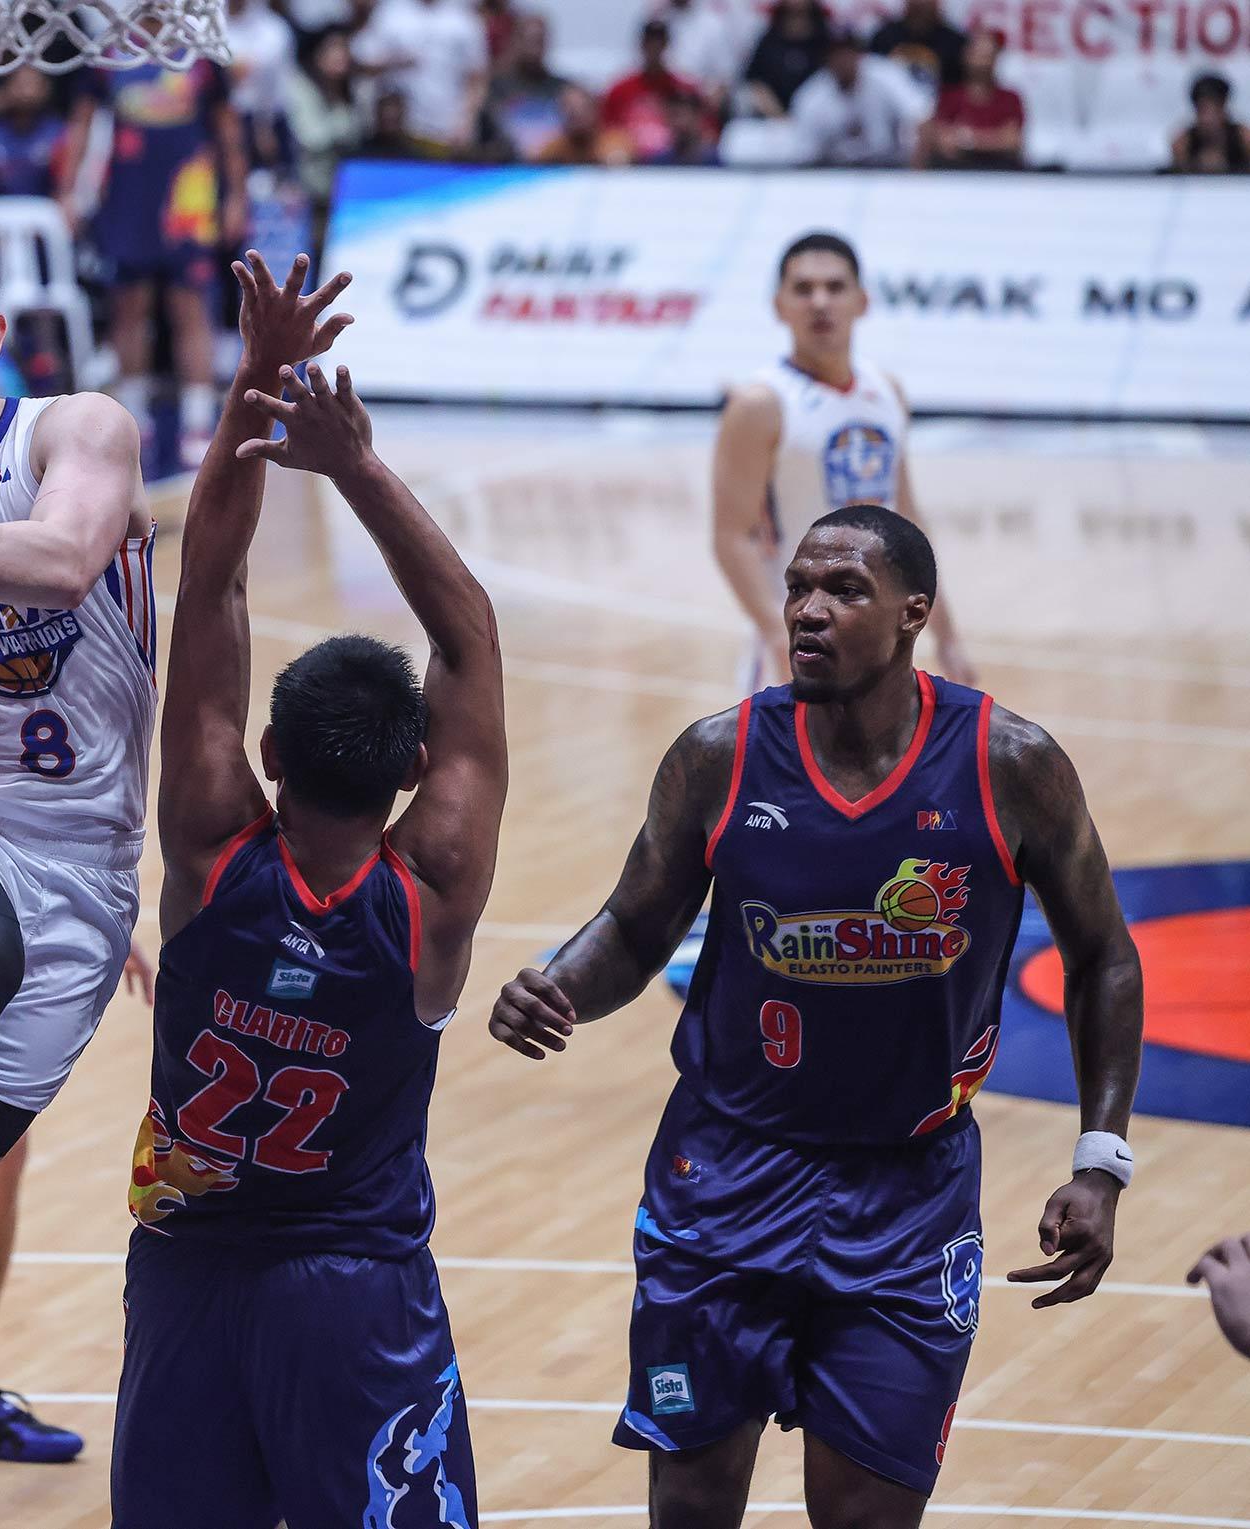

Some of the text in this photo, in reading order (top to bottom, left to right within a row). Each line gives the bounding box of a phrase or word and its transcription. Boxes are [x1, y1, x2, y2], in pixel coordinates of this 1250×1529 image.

[967, 0, 1250, 61] SECTIO
[1083, 277, 1197, 320] MO
[20, 709, 76, 778] 8
[746, 814, 772, 830] ANTA
[280, 933, 310, 955] ANTA
[740, 902, 965, 963] Rain OR Shine
[277, 972, 310, 983] Sista
[788, 962, 932, 975] ELASTO PAINTERS
[213, 988, 350, 1057] CLARITO
[759, 999, 802, 1069] 9
[177, 1028, 349, 1174] 22
[654, 1378, 684, 1395] Sista
